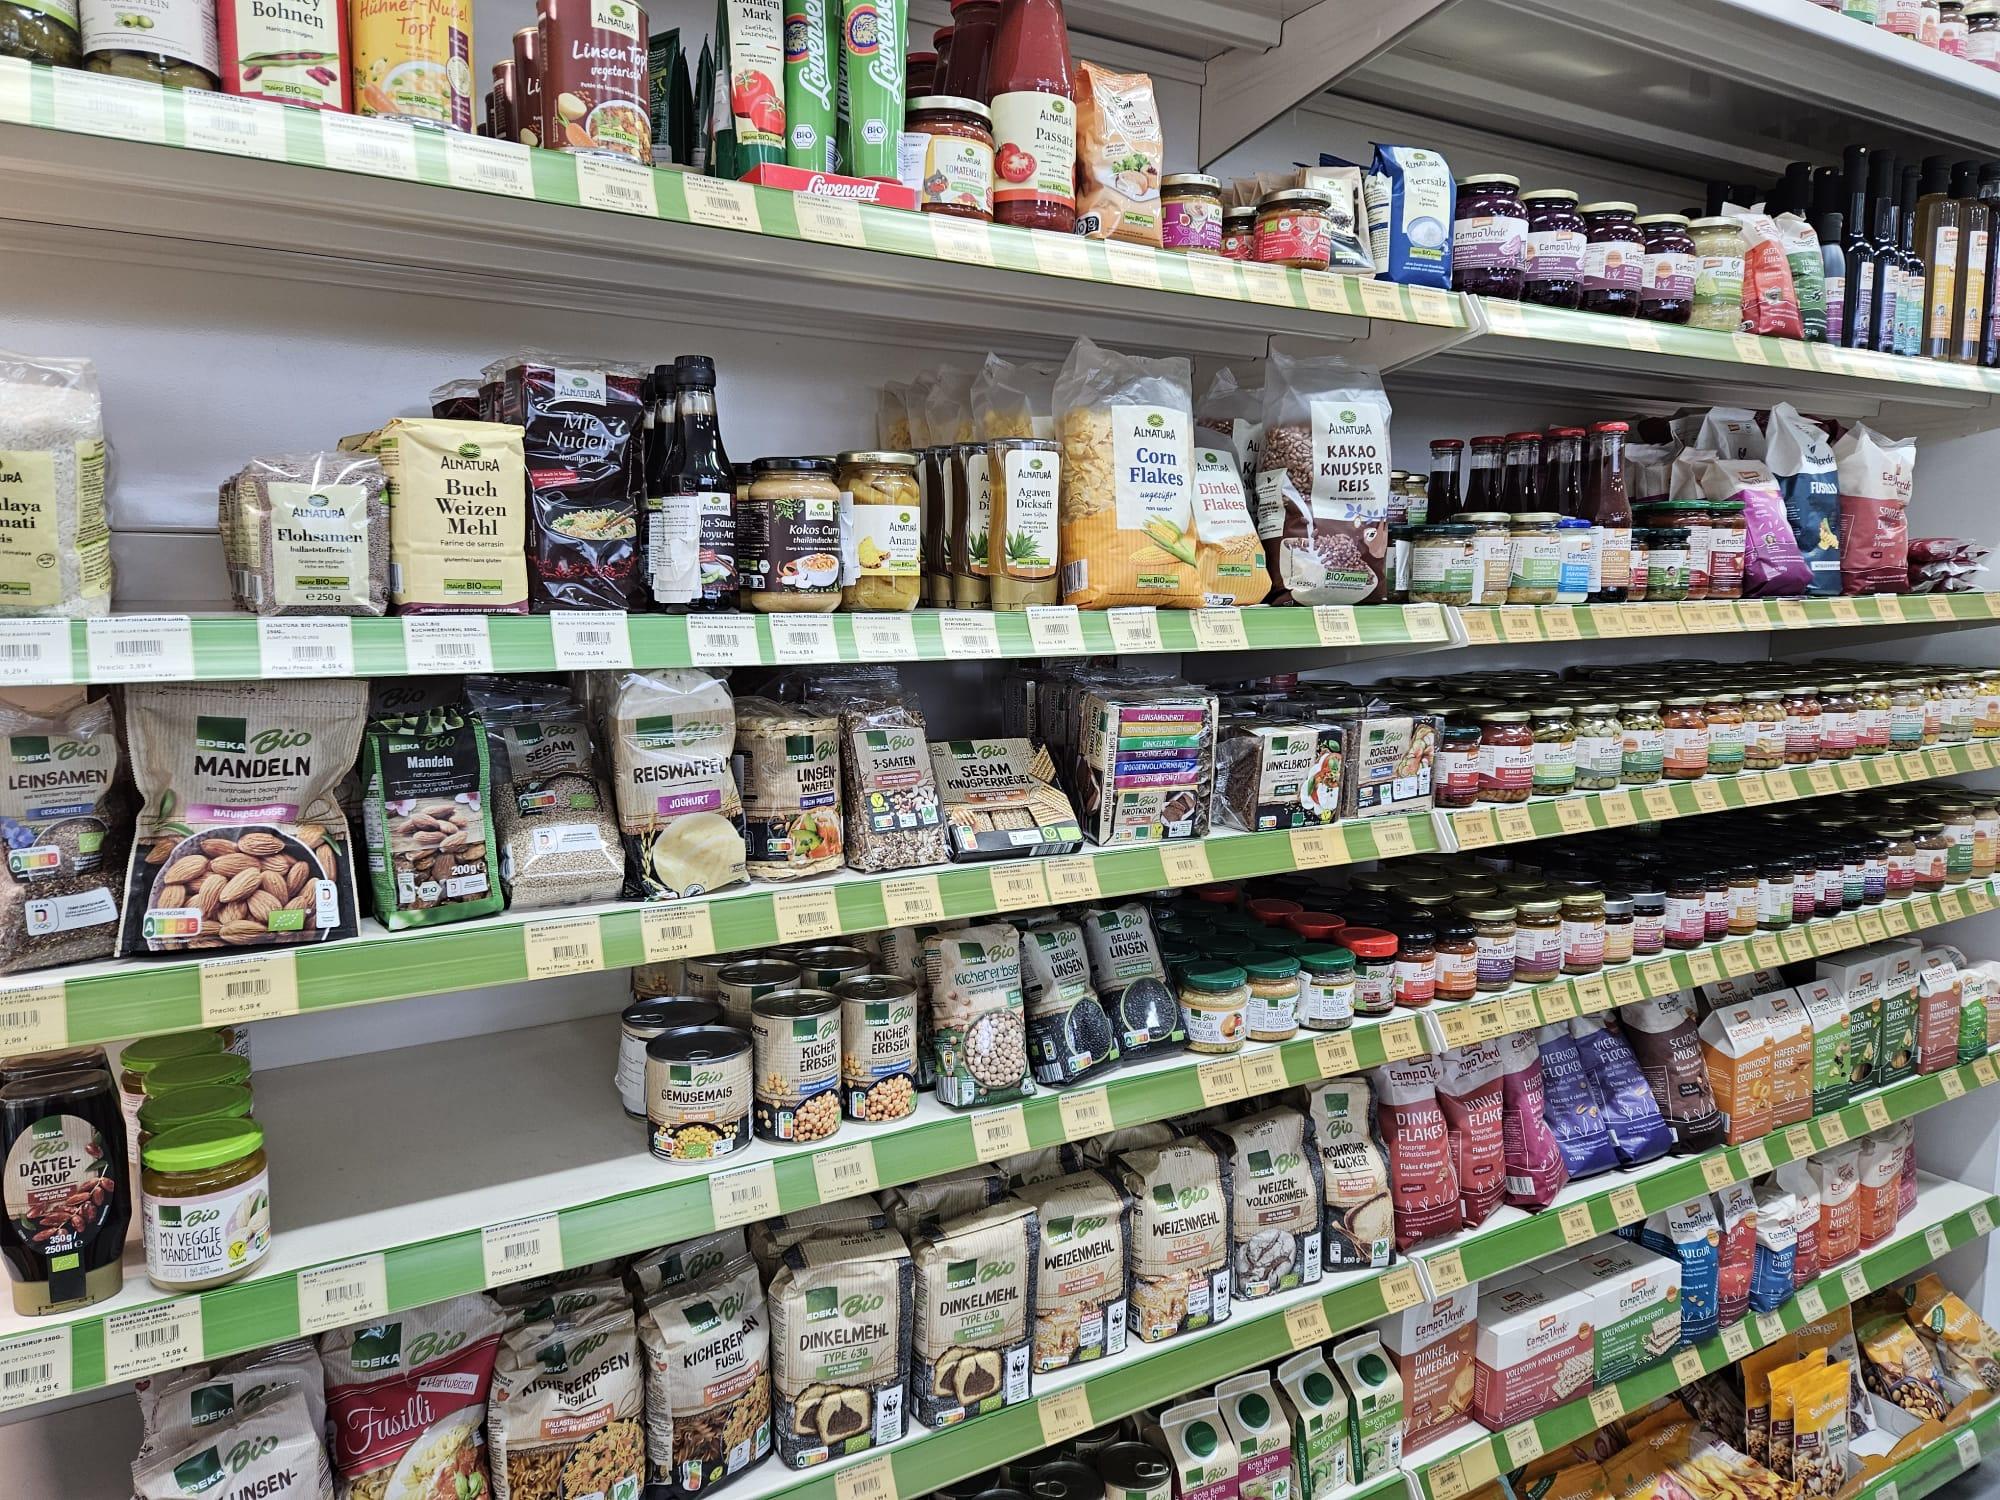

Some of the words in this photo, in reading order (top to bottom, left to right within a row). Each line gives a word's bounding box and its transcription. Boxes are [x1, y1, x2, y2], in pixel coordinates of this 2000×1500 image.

[253, 1, 324, 29] Bohnen
[742, 8, 772, 21] Mark
[397, 17, 436, 43] Topf
[572, 40, 627, 62] Linsen
[591, 64, 642, 82] vegetarisch
[808, 175, 881, 200] Löwensenf
[563, 413, 599, 431] Mie
[1328, 423, 1372, 436] ALNATURA
[546, 431, 616, 450] Nudeln
[1133, 427, 1176, 440] ALNATURA
[1136, 447, 1177, 468] Corn
[1327, 445, 1377, 459] KAKAO
[440, 455, 500, 472] ALNATURA
[1320, 462, 1383, 477] KNUSPER
[1129, 467, 1184, 487] Flakes
[1338, 478, 1370, 492] REIS
[445, 478, 498, 498] Buch
[1018, 488, 1051, 499] Agaven
[1199, 482, 1241, 496] Dinkel
[435, 497, 507, 517] Weizen
[1016, 499, 1053, 511] Dicksaft
[1202, 498, 1246, 512] Flakes
[277, 528, 363, 543] Flohsamen
[447, 518, 498, 537] Mehl
[789, 524, 819, 536] Kokos
[888, 535, 917, 546] Ananas
[250, 728, 312, 755] Bio
[390, 742, 420, 751] EDEKA
[526, 741, 575, 762] SESAM
[194, 756, 311, 777] MANDELN
[407, 755, 453, 769] Mandeln
[872, 756, 916, 769] 3-SAATEN
[960, 763, 1012, 778] SESAM
[10, 769, 107, 790] LEINSAMEN
[797, 767, 837, 782] LINSEN-
[947, 775, 1034, 790] KNUSPERRIEGEL
[802, 779, 834, 793] WAFFELN
[669, 794, 709, 809] JOGHURT
[1122, 807, 1155, 815] BROTKORB
[1121, 914, 1143, 930] Bio
[1111, 932, 1143, 944] BELUGA-
[1051, 949, 1079, 962] BELUGA-
[1109, 941, 1149, 958] LINSEN
[1478, 946, 1501, 954] Campo
[1052, 960, 1084, 978] LINSEN
[1887, 1000, 1903, 1011] PIZZA
[874, 1026, 910, 1042] KICHER-
[802, 1038, 838, 1056] KICHER-
[872, 1039, 910, 1054] ERBSEN
[800, 1055, 837, 1072] ERBSEN
[1774, 1057, 1794, 1070] KEKSE
[1390, 1070, 1423, 1081] Campo
[1737, 1070, 1763, 1084] COOKIES
[661, 1087, 732, 1103] GEMÜSEMAIS
[1396, 1109, 1442, 1125] DINKEL
[1326, 1120, 1353, 1139] Bio
[1398, 1125, 1443, 1141] FLAKES
[1323, 1142, 1368, 1158] ROHROHR-
[19, 1158, 81, 1178] DATTEL-
[1274, 1151, 1300, 1174] Bio
[1333, 1156, 1369, 1168] ZUCKER
[32, 1171, 71, 1186] SIRUP
[1258, 1177, 1298, 1195] WEIZEN-
[1177, 1186, 1209, 1208] Bio
[1246, 1188, 1308, 1207] VOLLKORNMEHL
[184, 1209, 220, 1227] Bio
[1075, 1216, 1107, 1237] Bio
[1152, 1214, 1219, 1237] WEIZENMEHL
[1671, 1220, 1694, 1229] Campo
[160, 1232, 173, 1246] MY
[178, 1227, 220, 1246] VEGGIE
[161, 1241, 222, 1262] MANDELMUS
[1045, 1240, 1114, 1270] WEIZENMEHL
[229, 1258, 246, 1268] VEGAN
[978, 1260, 1015, 1283] Bio
[841, 1295, 884, 1317] Bio
[940, 1287, 1018, 1316] DINKELMEHL
[984, 1310, 1000, 1321] 630
[1602, 1321, 1630, 1338] VOLLKORN
[1630, 1308, 1664, 1328] KNÄCKEBROT
[1416, 1320, 1443, 1337] Campo
[801, 1323, 889, 1352] DINKELMEHL
[162, 1348, 181, 1358] 12.99
[351, 1353, 401, 1370] EDEKA
[405, 1330, 466, 1364] Bio
[851, 1348, 868, 1360] 630
[1415, 1345, 1448, 1365] DINKEL
[1414, 1351, 1460, 1379] ZWIEBACK
[1506, 1360, 1537, 1379] VOLLKORN
[1538, 1346, 1575, 1367] KNÄCKEBROT
[35, 1385, 51, 1393] 4.29
[426, 1377, 475, 1391] Hartweizen
[557, 1386, 597, 1407] FUSILLI
[347, 1395, 436, 1455] Fusilli
[225, 1435, 279, 1473] Bio
[1248, 1461, 1265, 1472] Rote
[1264, 1455, 1279, 1467] Bete
